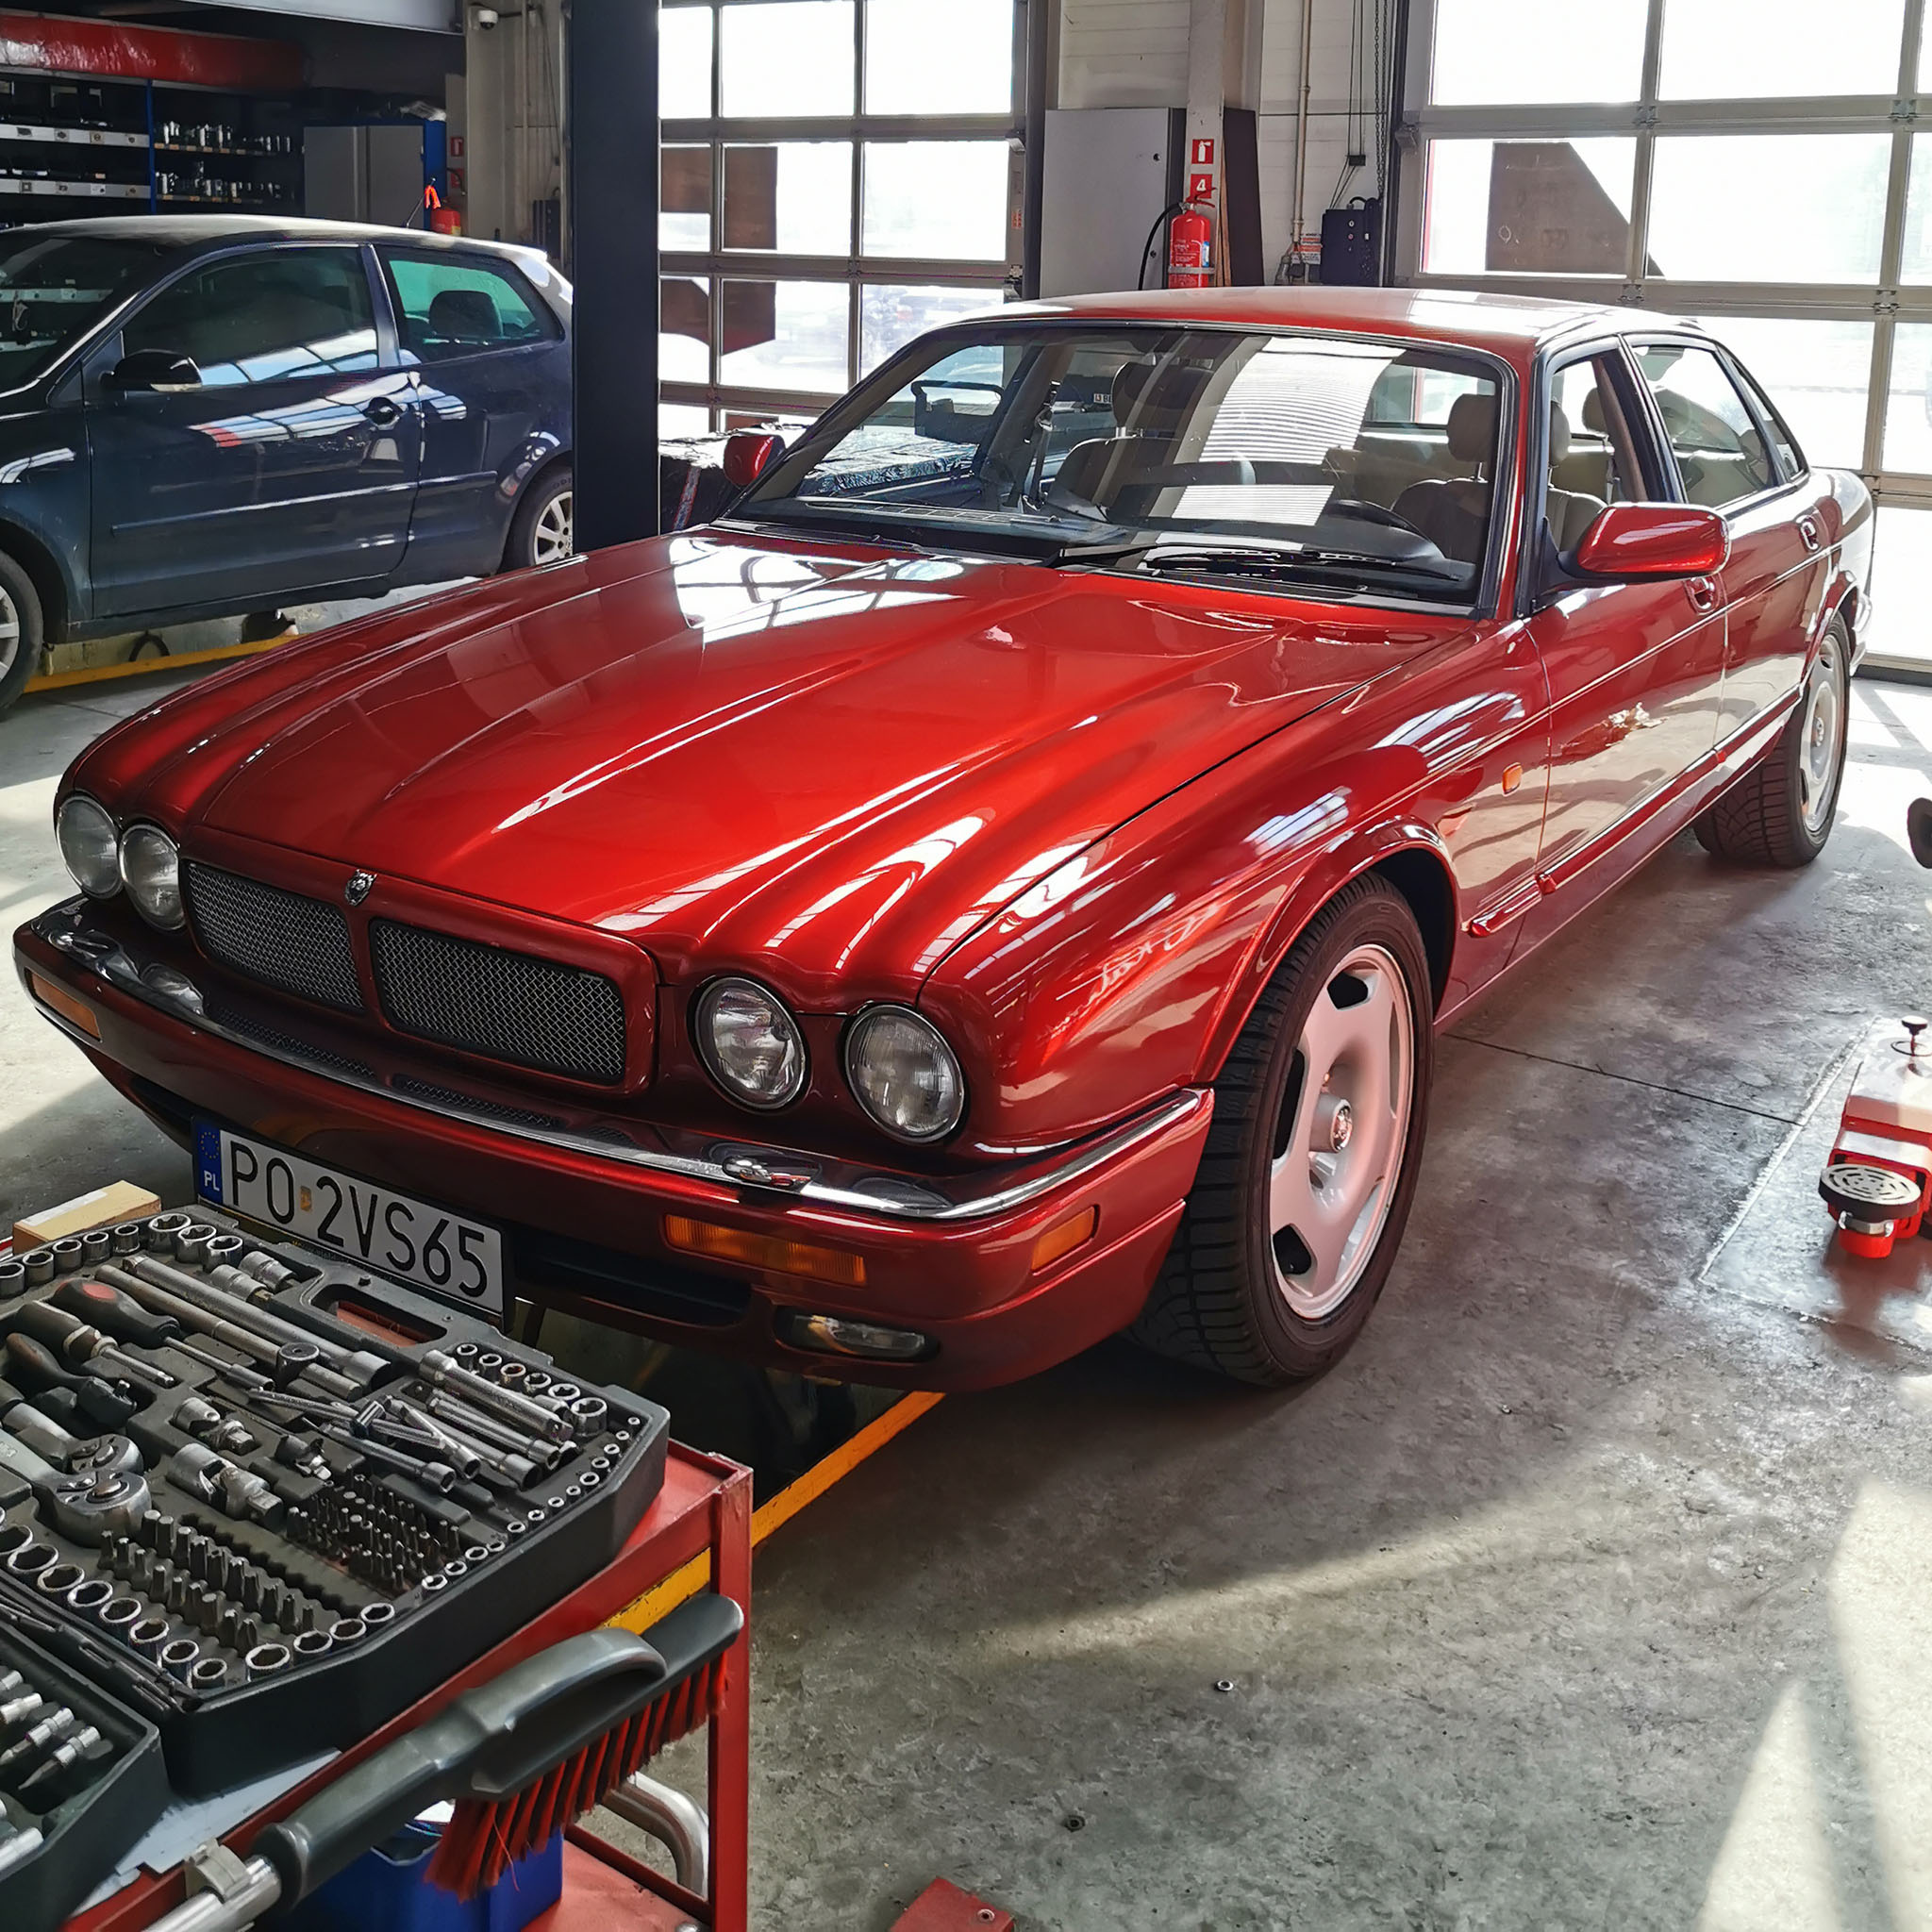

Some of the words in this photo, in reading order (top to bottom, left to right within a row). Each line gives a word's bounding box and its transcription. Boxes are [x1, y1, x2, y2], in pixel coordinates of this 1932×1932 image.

[1196, 179, 1207, 192] 4
[204, 1170, 220, 1191] PL
[316, 1175, 489, 1298] 2VS65
